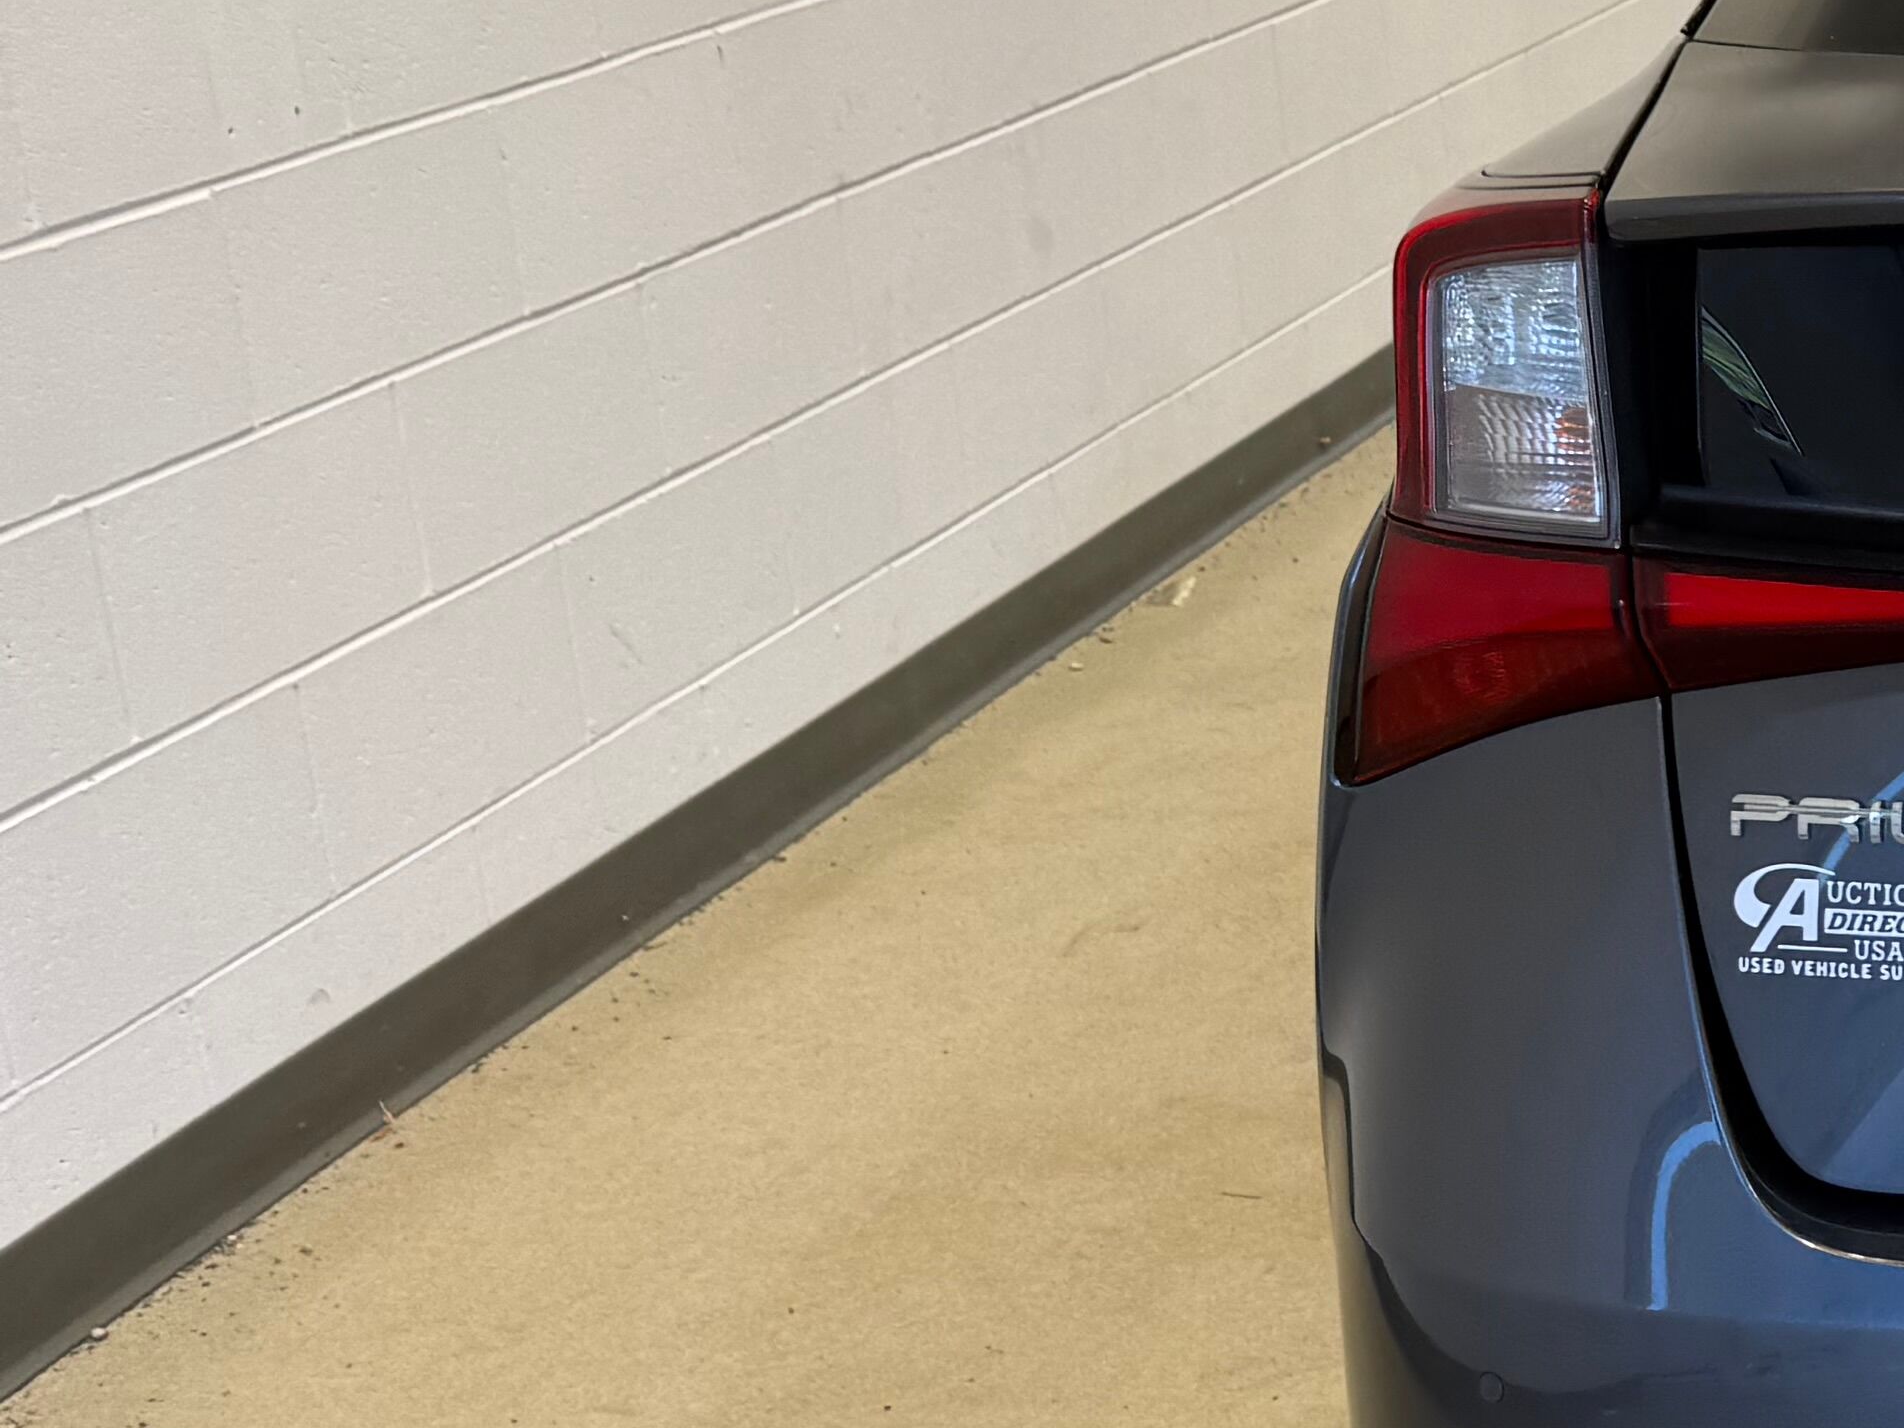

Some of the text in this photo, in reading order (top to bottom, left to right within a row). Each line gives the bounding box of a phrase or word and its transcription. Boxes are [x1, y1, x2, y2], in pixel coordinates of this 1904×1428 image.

[1853, 940, 1904, 962] USA
[1738, 956, 1786, 975] USED
[1791, 960, 1873, 980] VEHICLE
